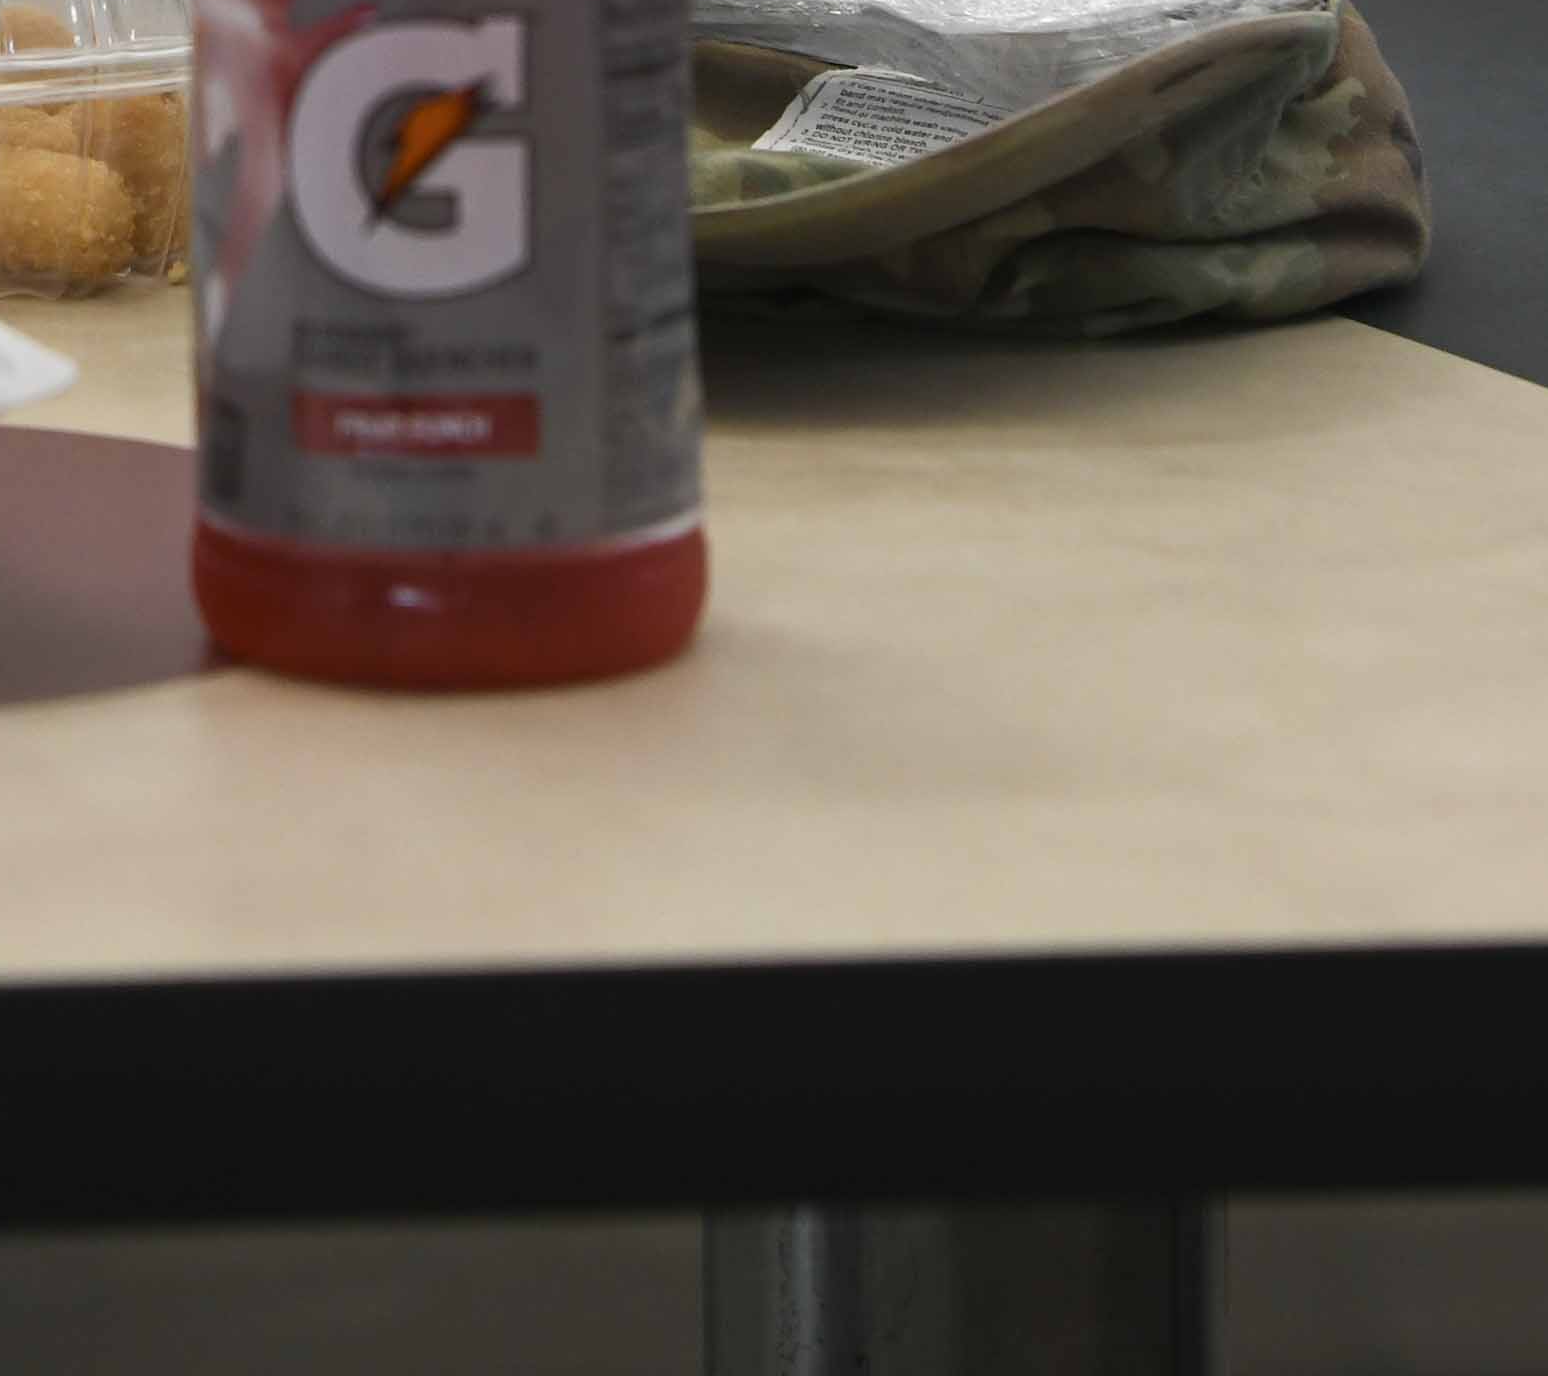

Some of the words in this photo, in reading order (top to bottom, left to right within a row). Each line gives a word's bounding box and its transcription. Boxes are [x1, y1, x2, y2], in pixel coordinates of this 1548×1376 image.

[870, 113, 911, 125] machine
[912, 120, 939, 129] wash
[815, 124, 852, 136] without
[853, 130, 893, 142] chlorine
[881, 125, 904, 134] cold
[904, 128, 932, 138] water
[933, 134, 953, 142] and
[854, 139, 888, 150] WRING
[891, 144, 905, 152] OR
[288, 12, 533, 299] G
